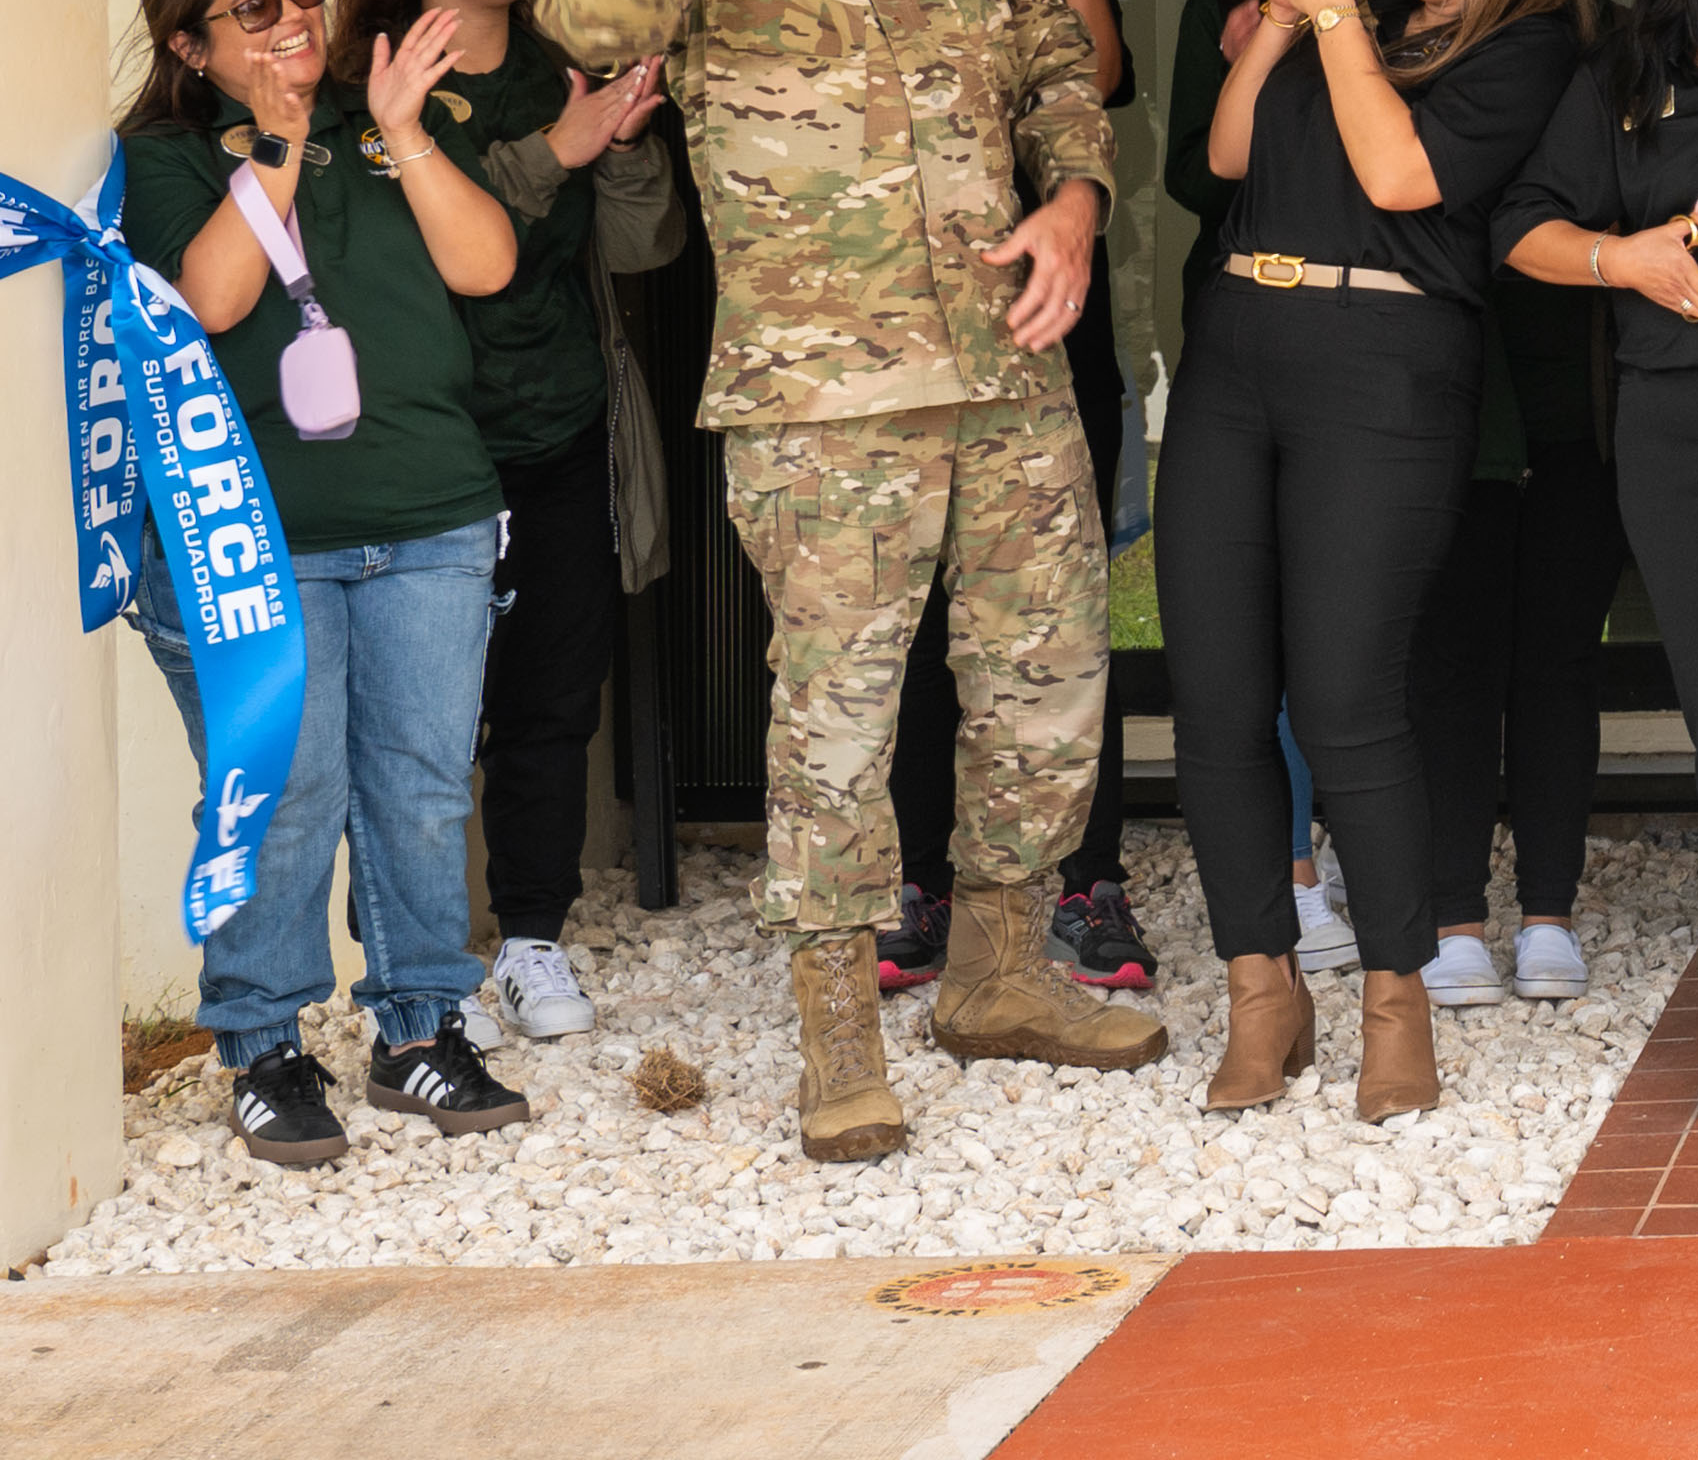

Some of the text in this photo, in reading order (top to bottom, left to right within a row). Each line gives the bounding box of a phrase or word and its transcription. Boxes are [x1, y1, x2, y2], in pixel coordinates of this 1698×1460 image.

[77, 303, 94, 368] FORCE
[77, 378, 89, 411] AIR
[80, 421, 92, 530] ANDERSEN
[142, 359, 222, 645] SUPPORT SQUADRON
[164, 340, 271, 640] FORCE
[236, 455, 254, 489] AIR
[247, 498, 274, 564] FORCE
[263, 573, 286, 627] BASE
